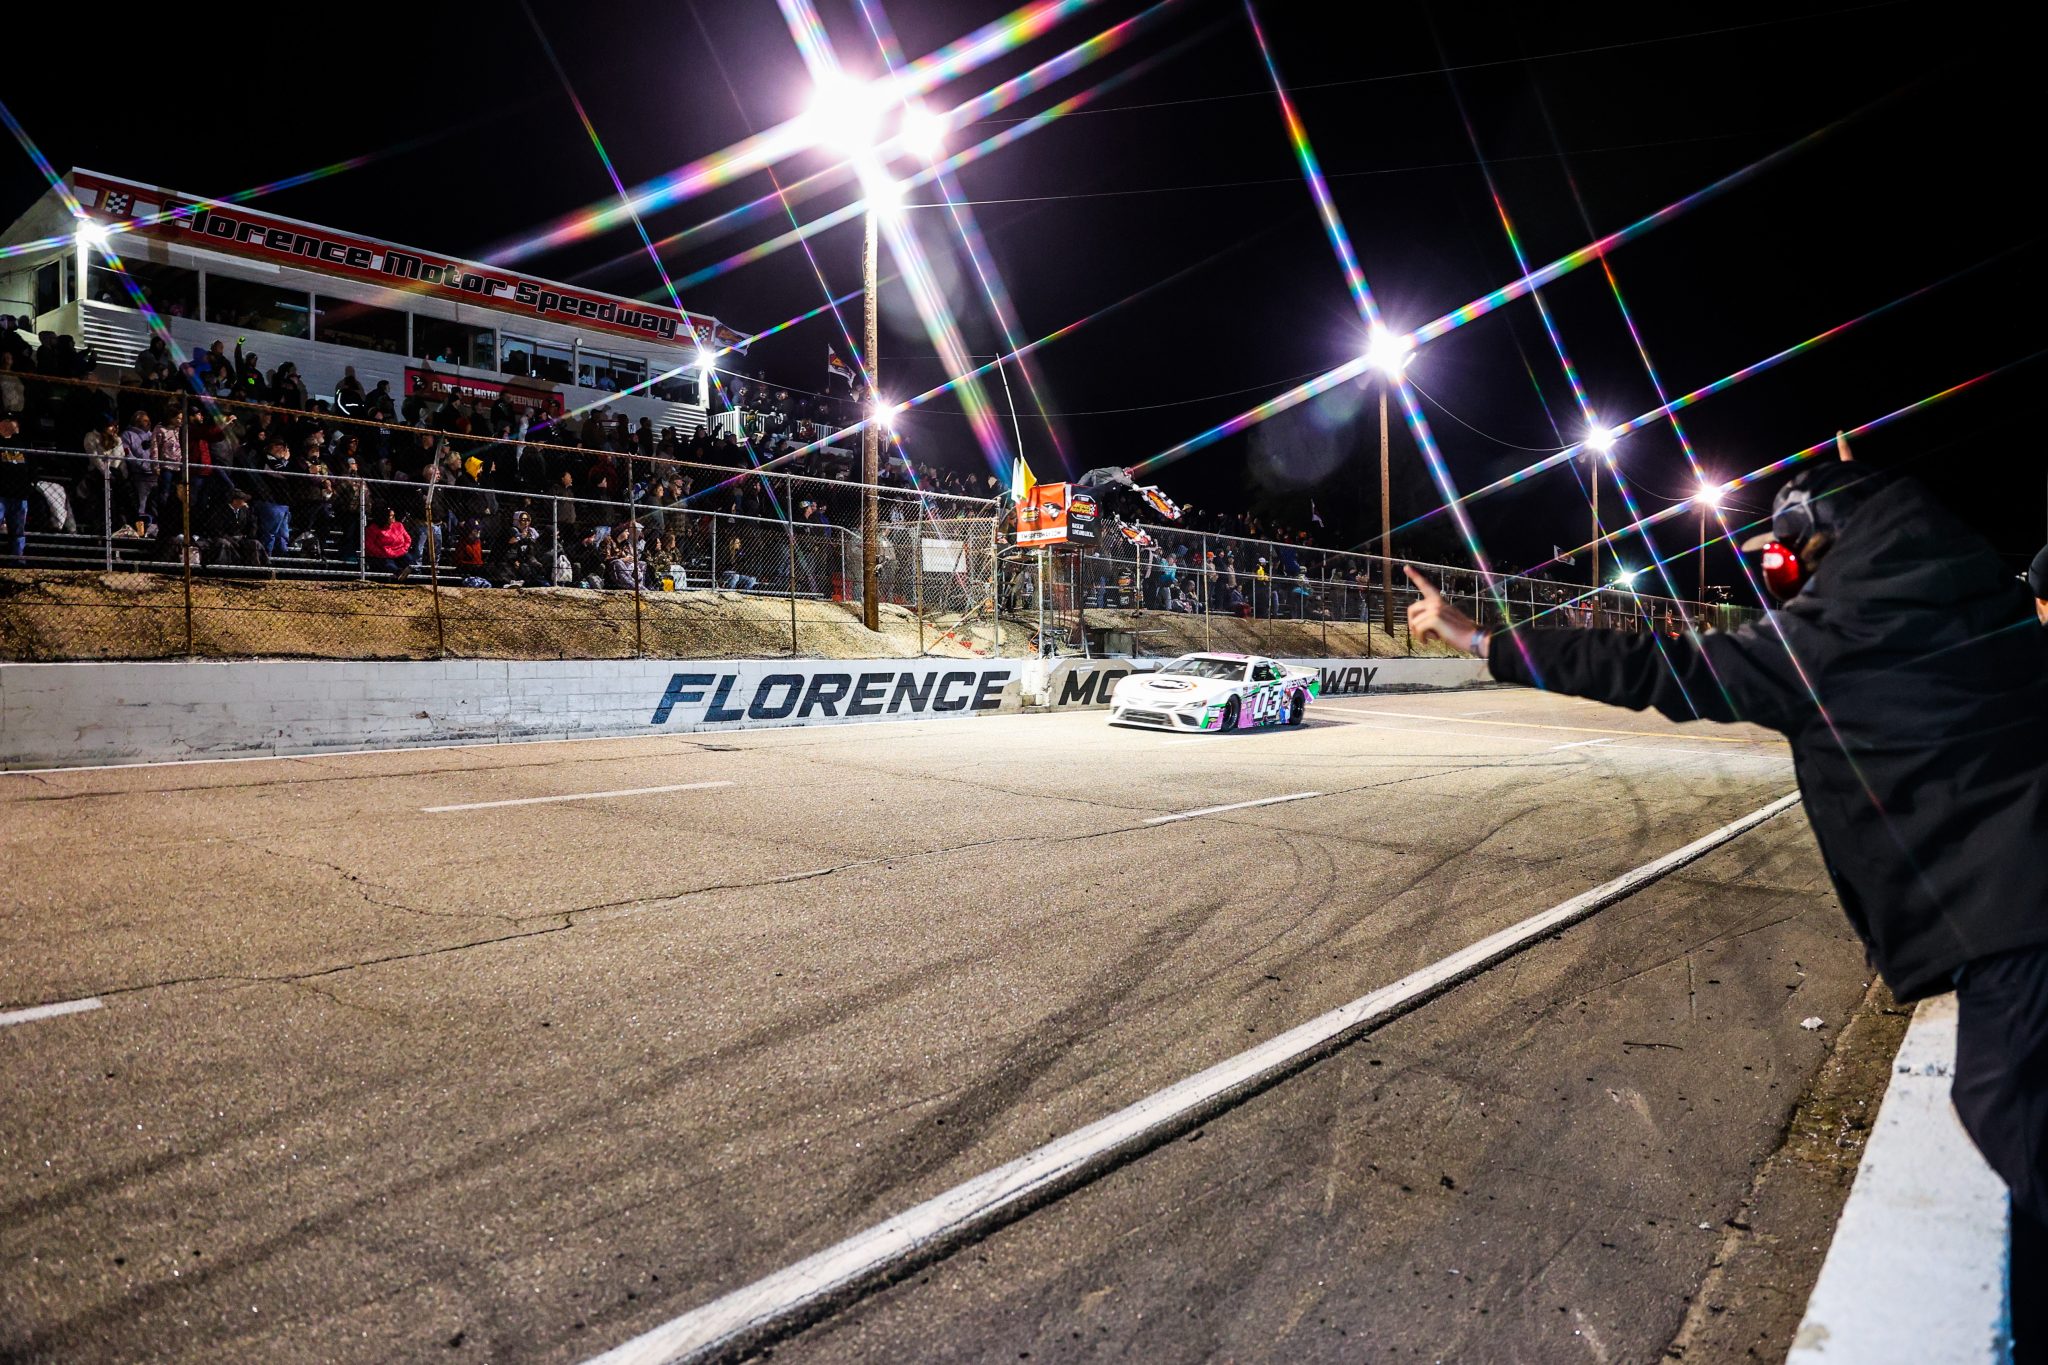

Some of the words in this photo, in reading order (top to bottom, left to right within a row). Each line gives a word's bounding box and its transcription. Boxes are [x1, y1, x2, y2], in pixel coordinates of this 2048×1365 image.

[160, 199, 373, 270] Florence
[382, 250, 507, 297] Motor
[514, 281, 679, 340] Speedway
[432, 381, 473, 397] FLORCE
[511, 395, 543, 408] PEEDWAY
[651, 671, 1011, 725] FLORENCE
[1058, 669, 1156, 706] MO
[1254, 685, 1282, 719] 03
